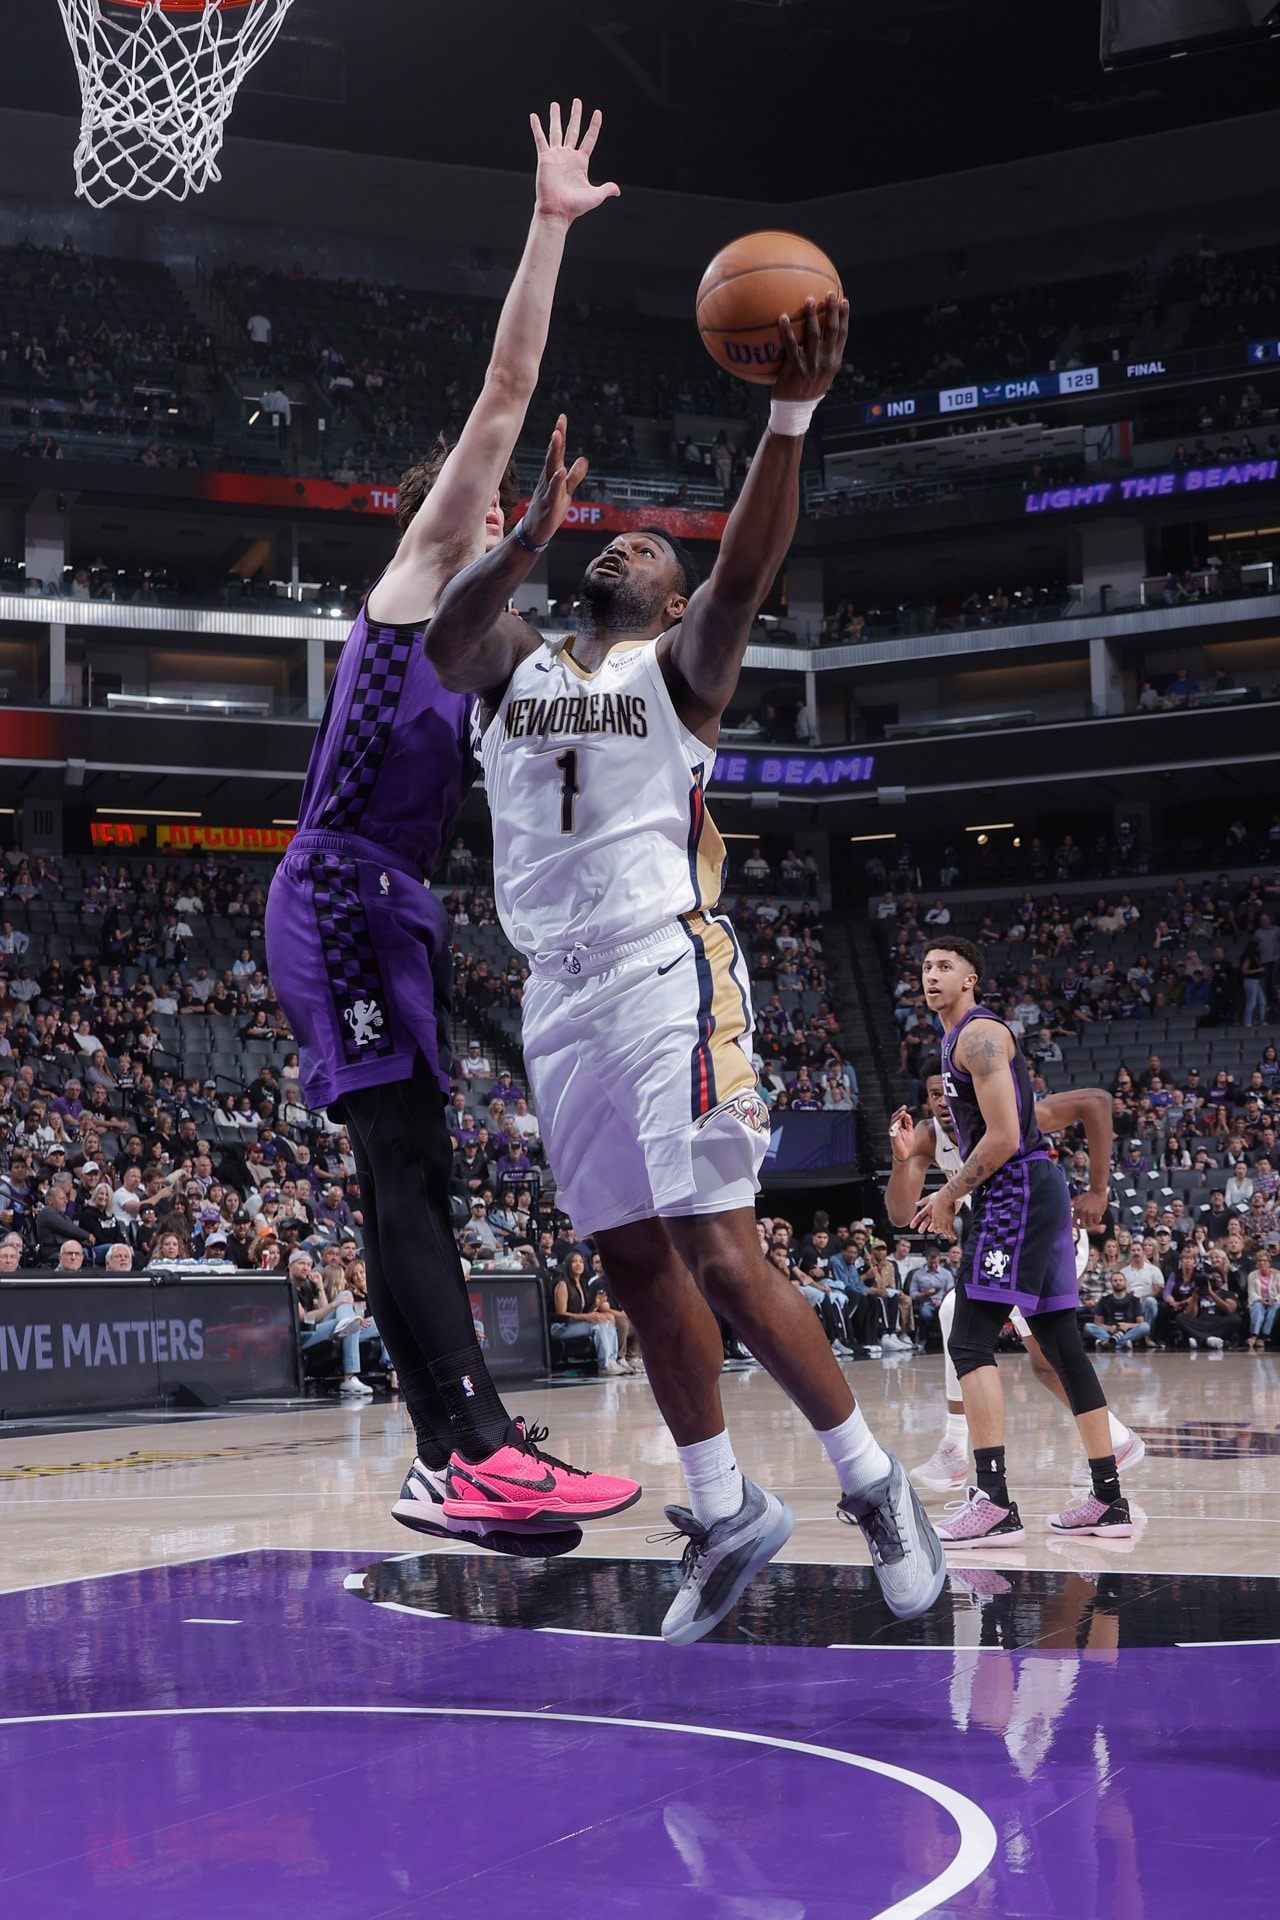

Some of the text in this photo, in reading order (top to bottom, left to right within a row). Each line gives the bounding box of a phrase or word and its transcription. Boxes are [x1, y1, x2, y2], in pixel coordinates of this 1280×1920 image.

[887, 361, 1166, 417] IND 108 CHA 129 FINAL
[371, 490, 397, 509] TH
[1025, 461, 1279, 512] LIGHT THE BEAM!
[555, 747, 580, 835] 1
[761, 756, 875, 785] BEAM!
[32, 810, 54, 835] 110
[0, 1317, 204, 1372] IVE MATTERS
